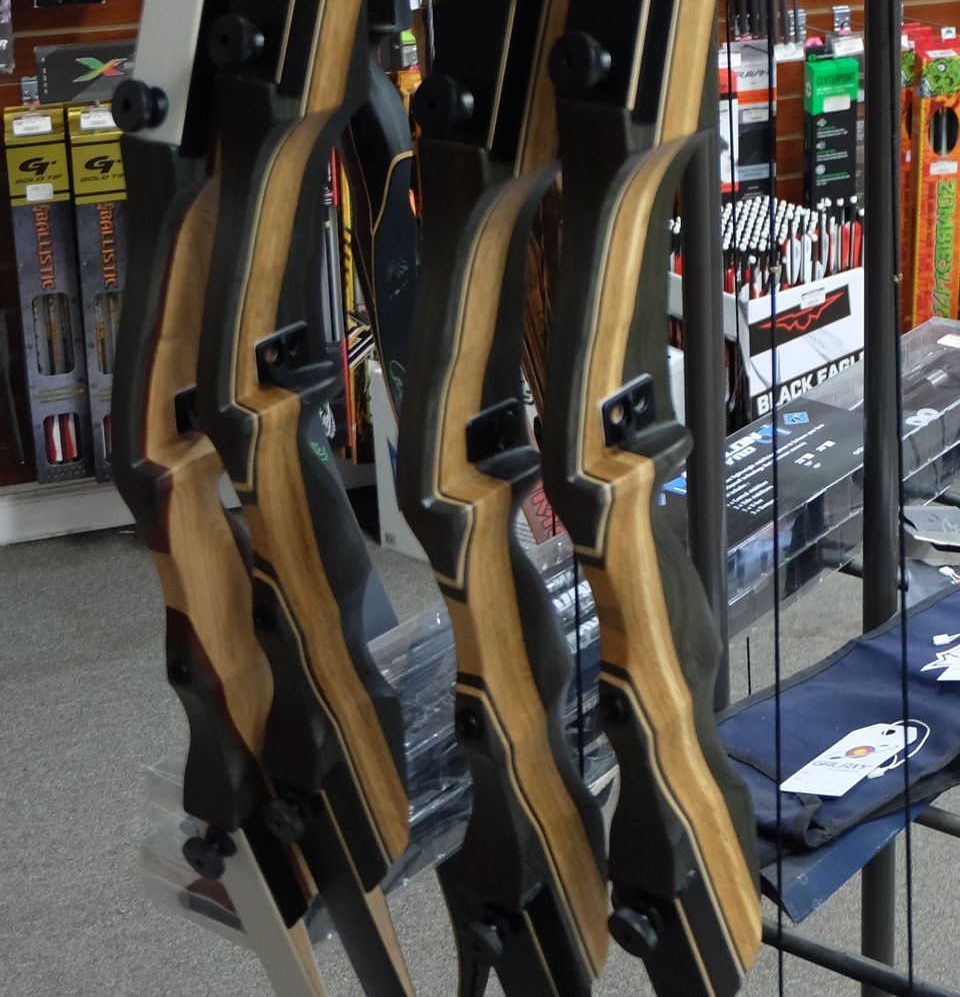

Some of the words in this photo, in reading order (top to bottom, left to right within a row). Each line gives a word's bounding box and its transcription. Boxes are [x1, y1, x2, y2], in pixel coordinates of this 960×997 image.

[737, 67, 769, 78] RAVIN
[15, 176, 46, 185] GOLD
[80, 175, 110, 183] GOLD
[35, 210, 57, 291] BALLISTIC
[98, 210, 119, 290] BALLISTIC
[756, 373, 815, 417] BLACK
[812, 760, 873, 770] GALAXY
